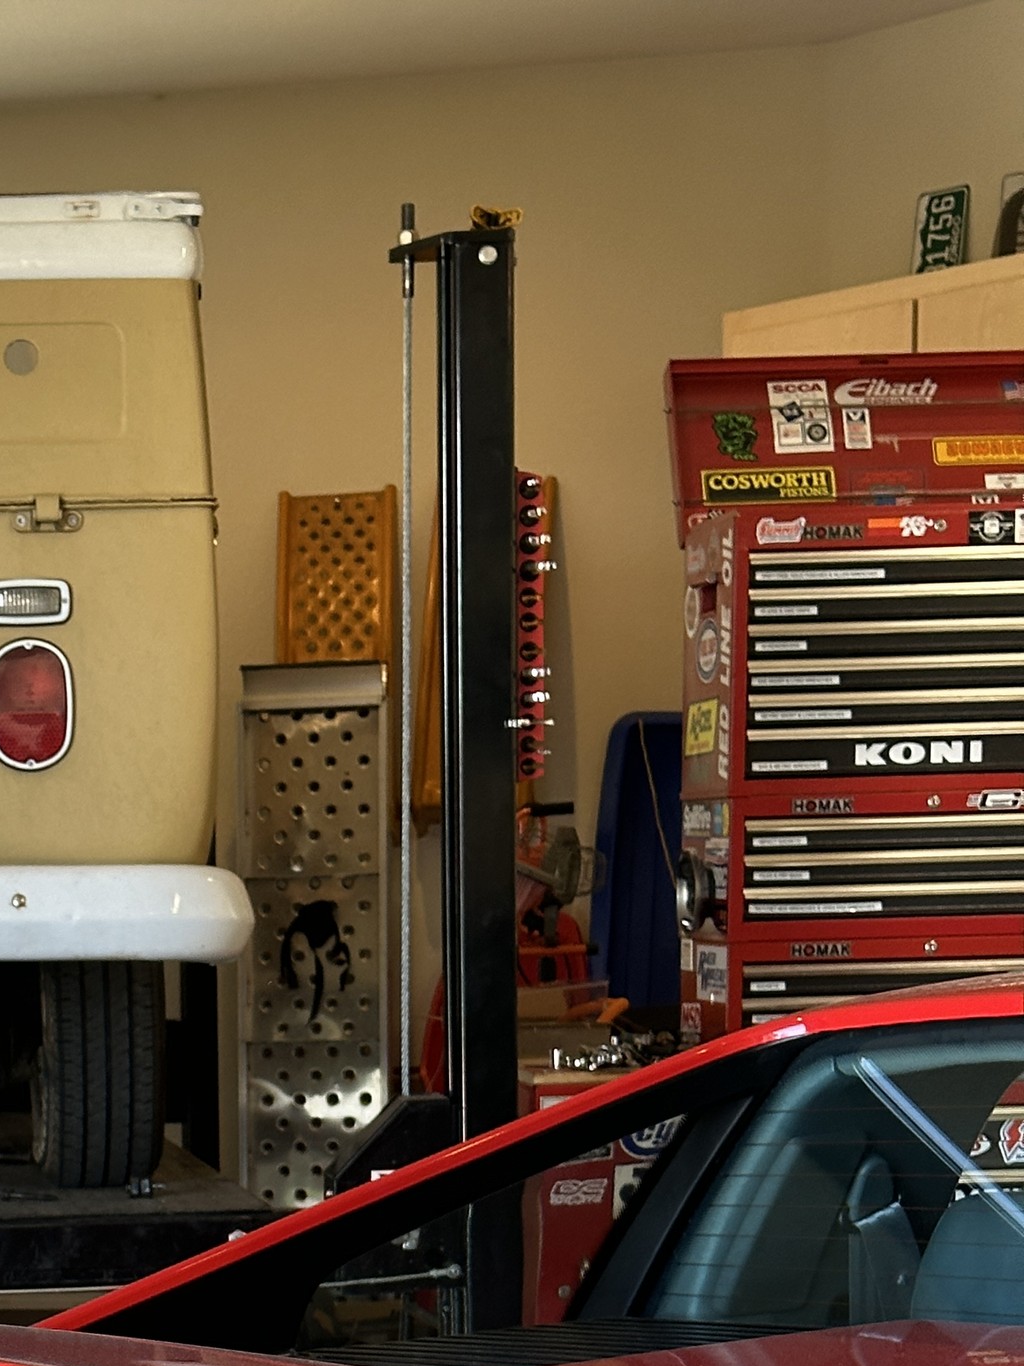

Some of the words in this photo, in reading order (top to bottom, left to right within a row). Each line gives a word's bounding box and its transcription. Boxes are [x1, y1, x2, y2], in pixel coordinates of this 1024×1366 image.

[925, 195, 955, 272] 1756
[772, 383, 823, 394] SCCA
[834, 378, 939, 405] Eibach
[709, 471, 827, 491] COSWORTH
[779, 486, 830, 498] PISTONS
[803, 526, 863, 539] HOMAK
[721, 528, 733, 587] OIL
[720, 604, 732, 687] LINE
[718, 704, 730, 780] RED
[855, 740, 983, 766] KONI
[793, 799, 853, 813] HOMAK
[791, 944, 851, 957] HOMAK
